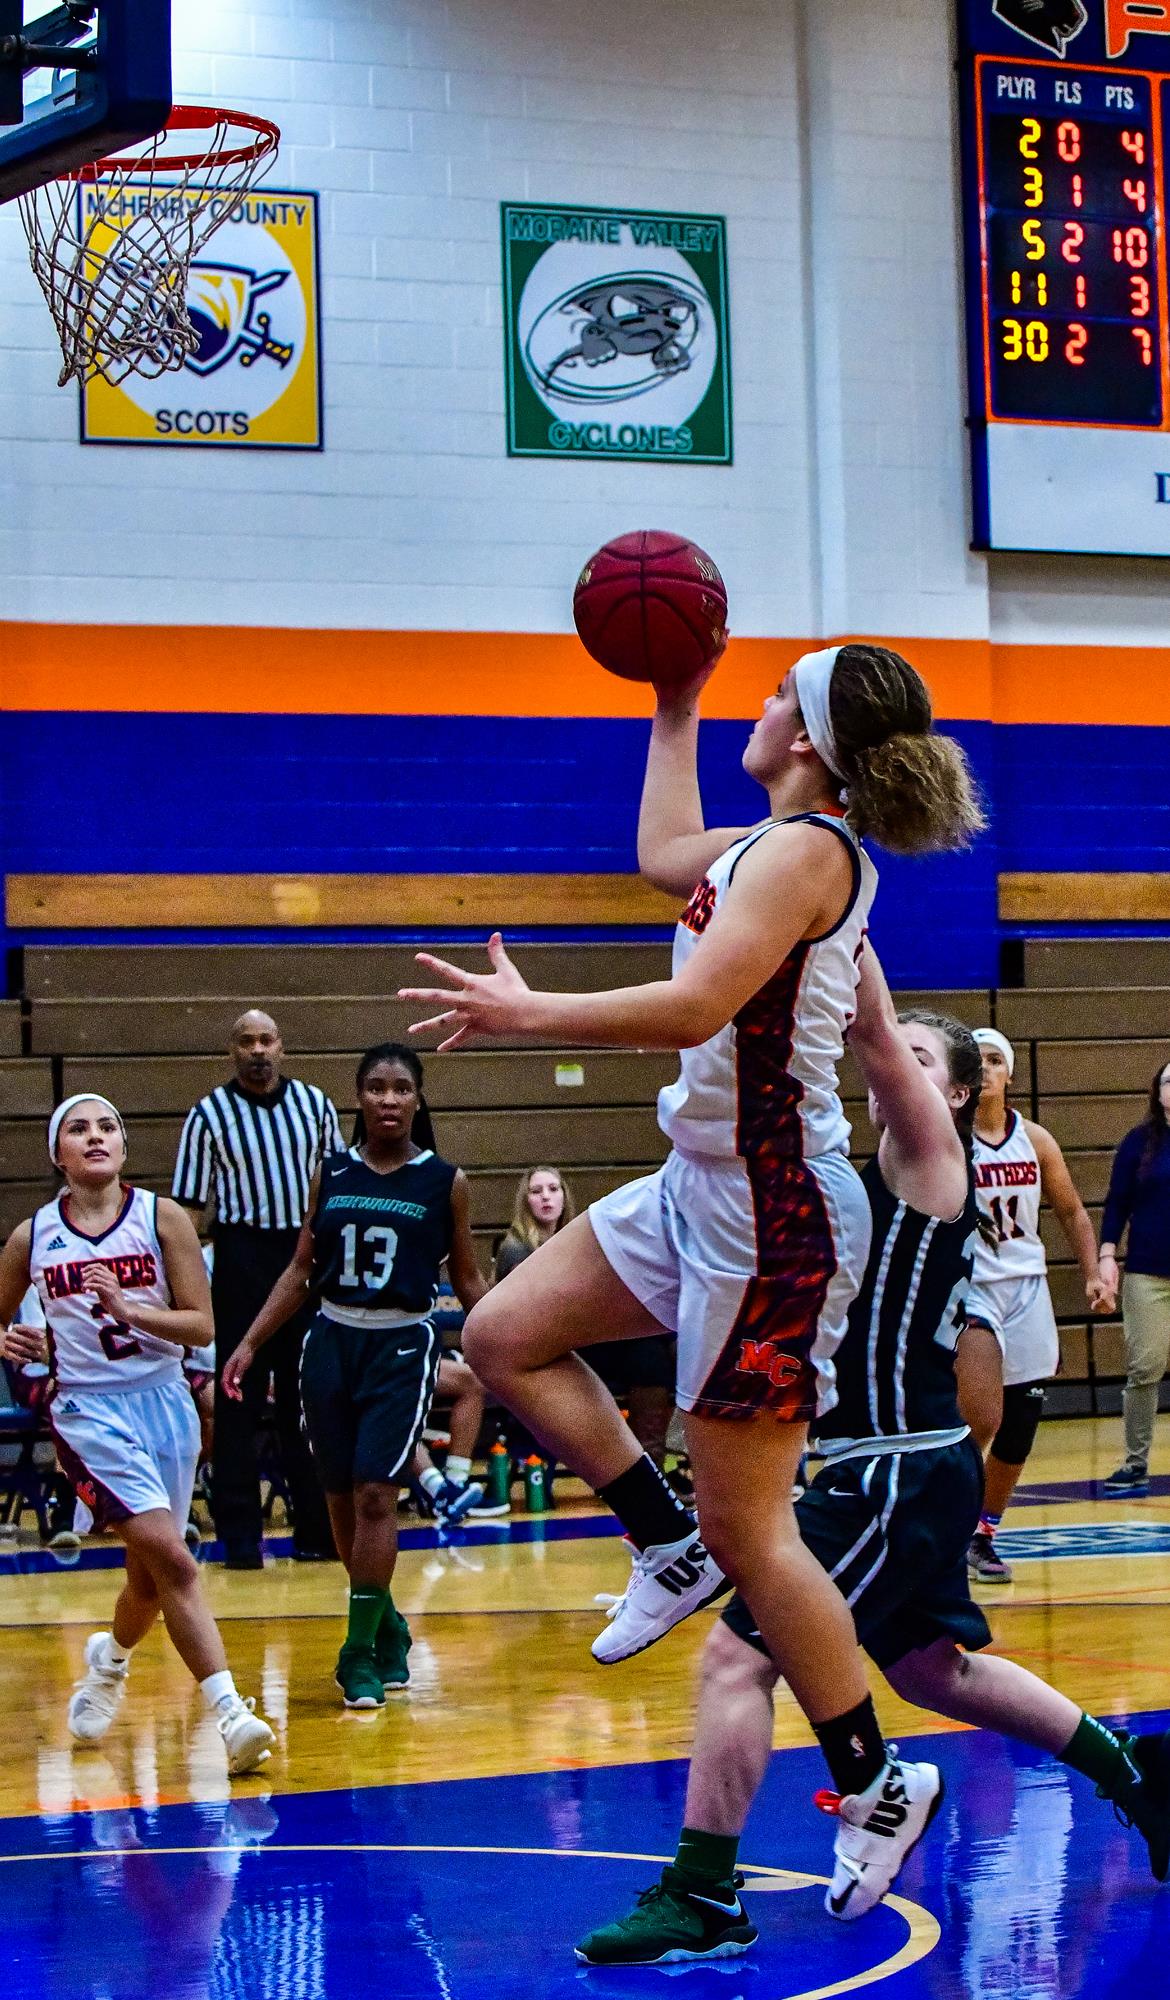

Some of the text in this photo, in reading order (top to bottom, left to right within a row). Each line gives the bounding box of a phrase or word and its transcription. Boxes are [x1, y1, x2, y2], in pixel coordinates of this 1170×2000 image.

[997, 75, 1134, 110] PLYR FLS PTS
[1019, 118, 1144, 165] 2 0 4
[1023, 167, 1146, 212] 3 1 4
[210, 199, 306, 226] COUNTY
[510, 215, 718, 252] MORAINE VALLEY
[1022, 219, 1148, 267] 5 2 10
[1011, 271, 1149, 316] 11 1 3
[1003, 319, 1151, 365] 30 2 7
[155, 409, 249, 435] SCOTS
[549, 422, 694, 452] CYCLONES
[974, 1161, 1037, 1188] NTHERS
[989, 1195, 1025, 1242] 11
[43, 1253, 157, 1300] PANERS
[339, 1223, 398, 1290] 13
[735, 1338, 801, 1387] MC
